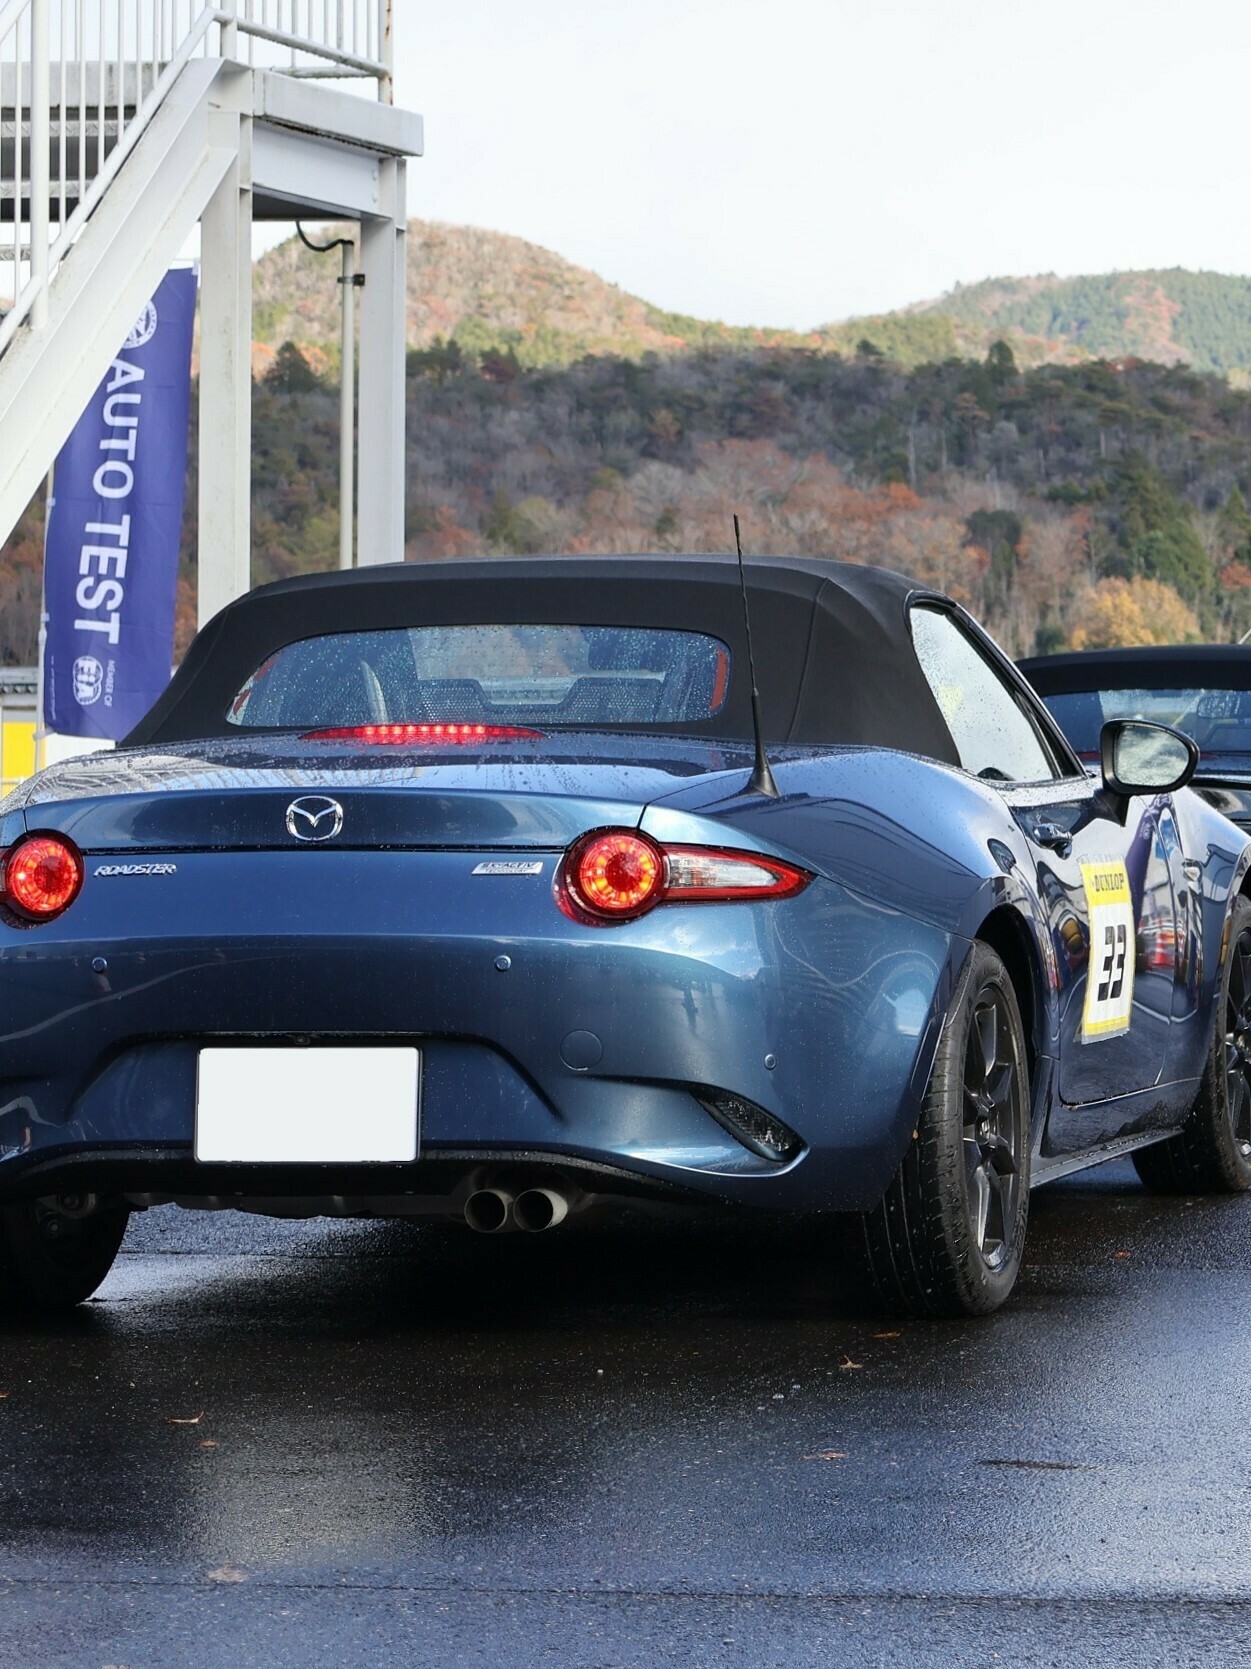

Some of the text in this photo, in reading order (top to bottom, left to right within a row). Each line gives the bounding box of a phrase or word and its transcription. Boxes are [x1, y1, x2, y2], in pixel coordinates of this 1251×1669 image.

[92, 358, 146, 499] AUTO
[74, 514, 131, 645] TEST
[93, 863, 178, 877] ROADSTER
[1094, 872, 1125, 893] DUNLOP
[1097, 924, 1127, 1002] 33
